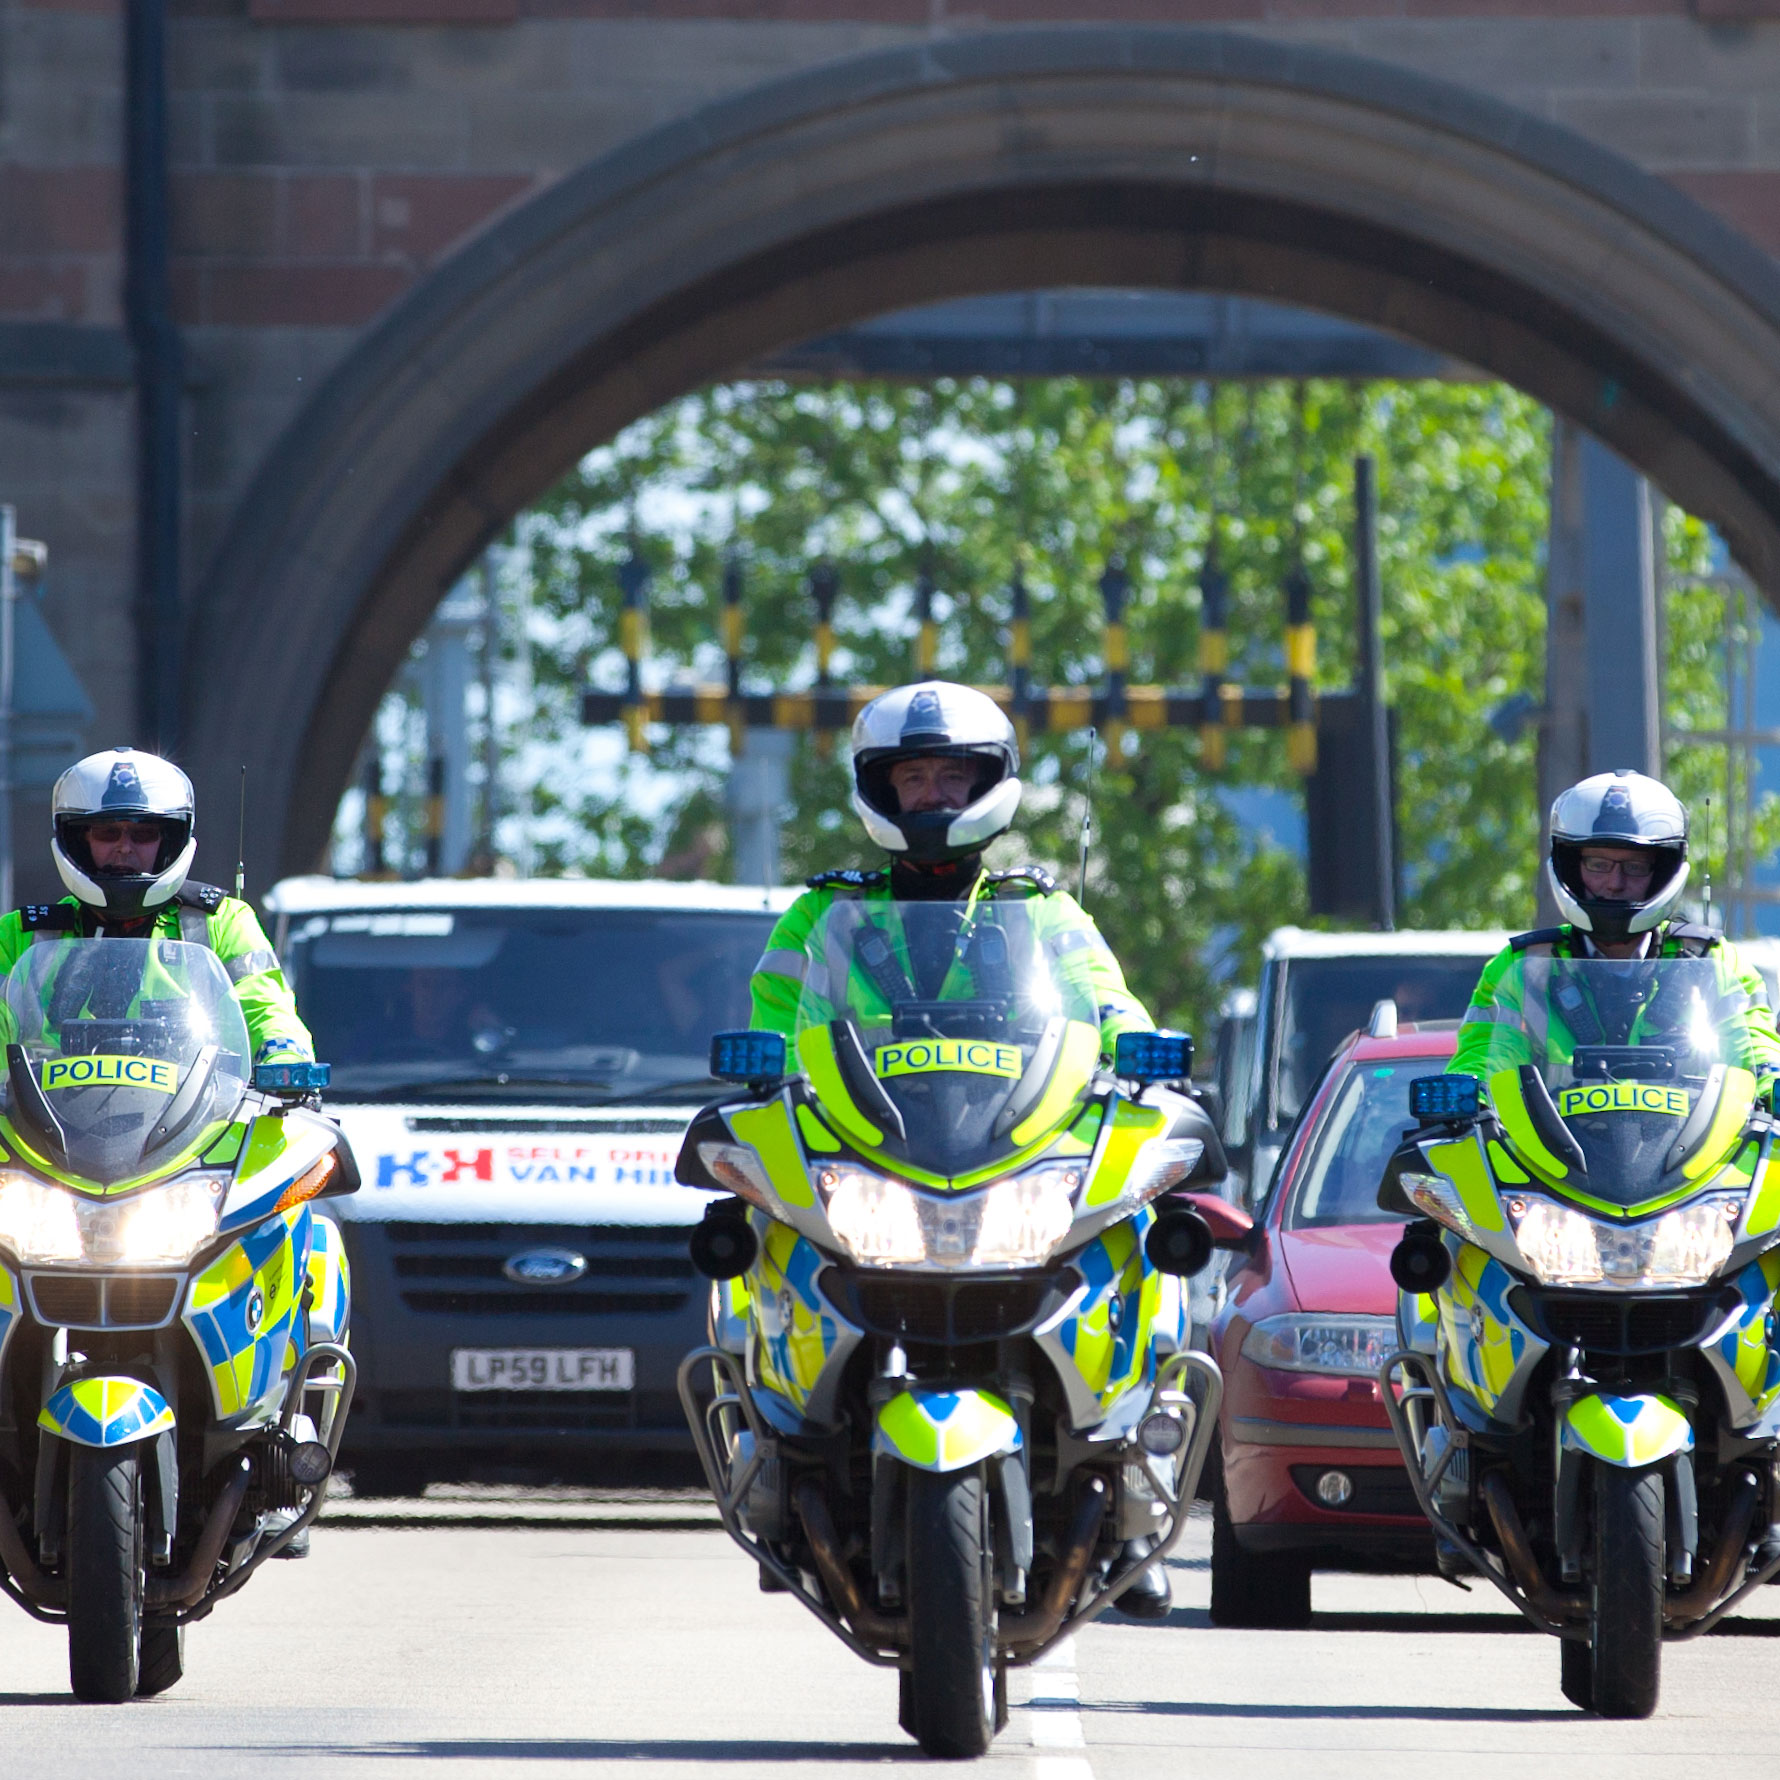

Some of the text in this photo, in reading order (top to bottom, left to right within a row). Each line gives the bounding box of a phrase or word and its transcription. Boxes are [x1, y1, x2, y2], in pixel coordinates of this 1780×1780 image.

[883, 1044, 1015, 1072] POLICE
[48, 1060, 169, 1086] POLICE
[1565, 1088, 1683, 1113] POLICE
[507, 1147, 681, 1163] SELF DRI
[509, 1165, 595, 1183] VAN
[467, 1356, 619, 1385] LP59 LFH
